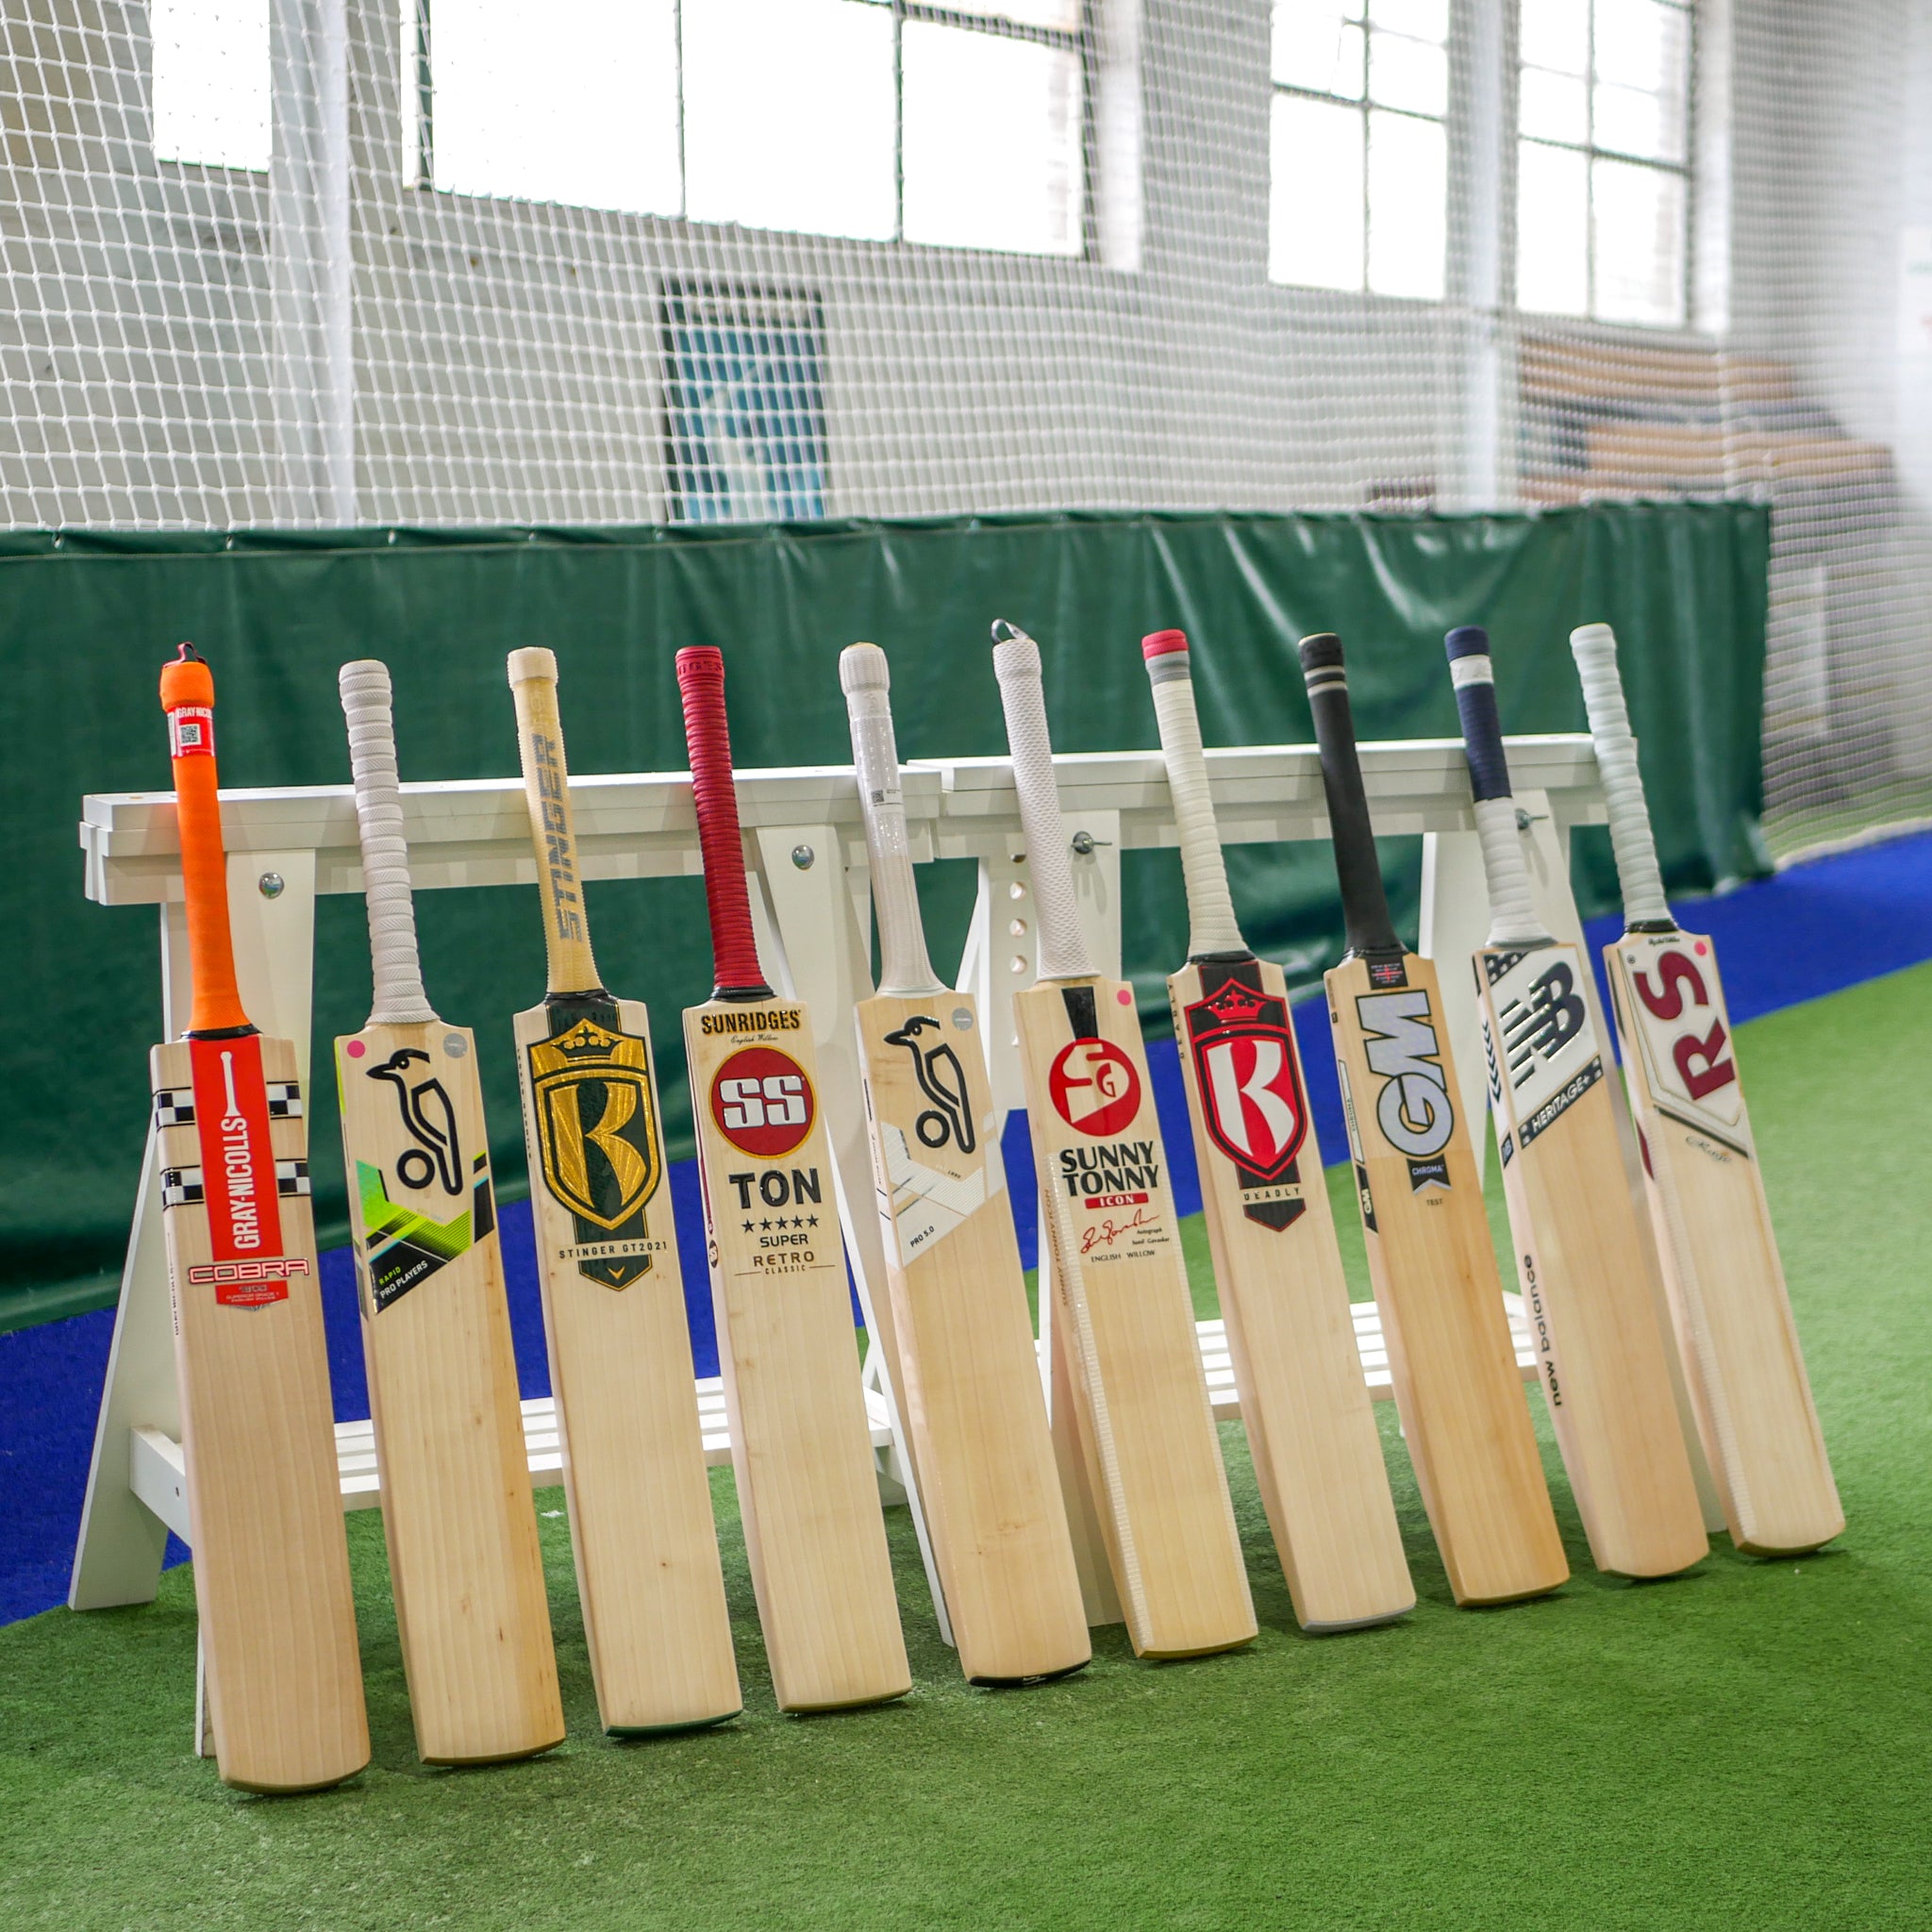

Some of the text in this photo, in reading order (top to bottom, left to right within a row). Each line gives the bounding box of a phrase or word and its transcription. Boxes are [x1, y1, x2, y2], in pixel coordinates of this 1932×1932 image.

[531, 732, 582, 942] STINGER
[701, 1009, 800, 1034] SUNRIDGES
[1633, 951, 1735, 1101] RS
[731, 1036, 755, 1044] English
[1355, 990, 1454, 1158] GM
[720, 1074, 807, 1129] SS
[1059, 1141, 1154, 1173] SUNNY
[221, 1117, 261, 1249] GRAY-NICOLLS
[728, 1168, 822, 1209] TON
[1062, 1165, 1158, 1196] TONNY
[1044, 1190, 1055, 1219] ICON
[1099, 1195, 1135, 1207] ICON
[1244, 1188, 1299, 1200] DEADLY
[1361, 1189, 1372, 1214] GM
[759, 1234, 808, 1248] SUPER
[910, 1225, 935, 1247] PRO 5.0
[1050, 1223, 1061, 1262] TONNY
[559, 1241, 667, 1258] STINGER GT2021
[753, 1251, 814, 1267] RETRO
[1091, 1250, 1155, 1262] ENGLISH WILLOW
[189, 1258, 309, 1284] COBRA
[378, 1266, 401, 1286] RAPID
[379, 1260, 428, 1298] PRO PLAYERS
[765, 1265, 806, 1274] CLASSIC
[1524, 1255, 1562, 1407] new balance
